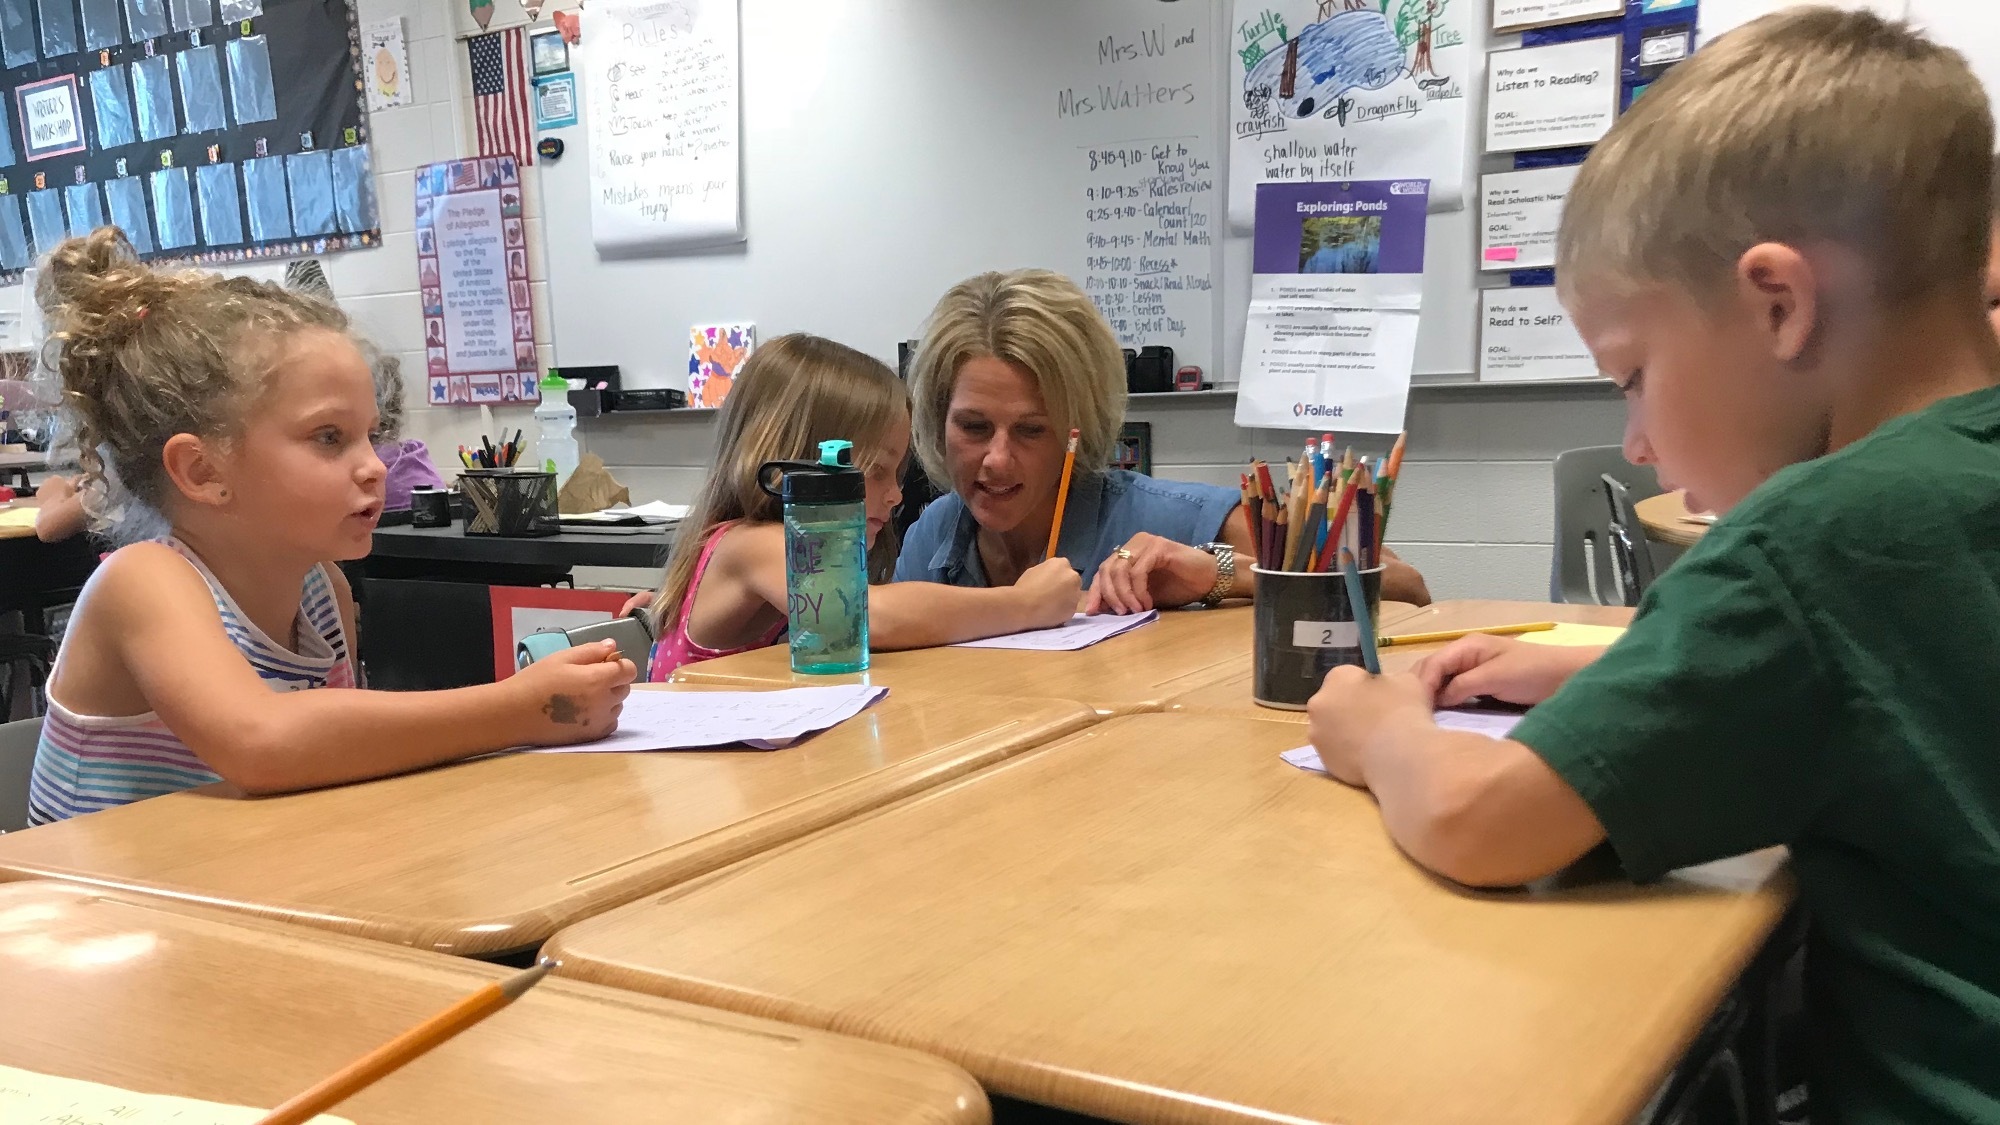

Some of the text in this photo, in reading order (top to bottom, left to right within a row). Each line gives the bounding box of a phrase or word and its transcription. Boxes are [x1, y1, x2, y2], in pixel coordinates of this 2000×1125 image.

[622, 20, 678, 47] Rules
[1237, 9, 1283, 42] Turtle
[1432, 24, 1463, 44] Tree
[1174, 28, 1194, 48] and
[1496, 70, 1599, 92] Listen to Reading?
[1497, 69, 1513, 77] Why
[1425, 83, 1461, 100] Tadpole
[627, 116, 653, 131] Touch
[1494, 112, 1518, 120] GOAL:
[33, 119, 72, 141] WORKSHOP
[1237, 114, 1285, 141] crayfish
[609, 149, 634, 167] Raise
[641, 151, 657, 167] your
[1151, 145, 1171, 161] Get
[1176, 143, 1188, 157] to
[1264, 138, 1358, 164] shallow water
[1158, 158, 1210, 177] Know You
[1265, 160, 1356, 183] water by itself
[603, 180, 727, 206] Mistakes means your
[1149, 182, 1179, 199] Rules
[1180, 179, 1212, 195] review
[1296, 200, 1389, 215] Exploring: Ponds
[1508, 195, 1544, 205] Scholastic
[447, 208, 485, 218] The Pledge
[1159, 212, 1207, 229] Count 120
[446, 219, 490, 230] of Allegiance
[1489, 224, 1512, 232] GOAL:
[1143, 229, 1178, 248] Mental
[1183, 230, 1211, 246] Math
[453, 269, 493, 278] United States
[466, 279, 491, 287] America
[1132, 291, 1162, 304] Lesson
[1132, 304, 1165, 317] Centers
[1154, 317, 1164, 332] of
[1490, 315, 1562, 327] Read to Self?
[1304, 404, 1344, 417] Follett
[1321, 629, 1332, 645] 2
